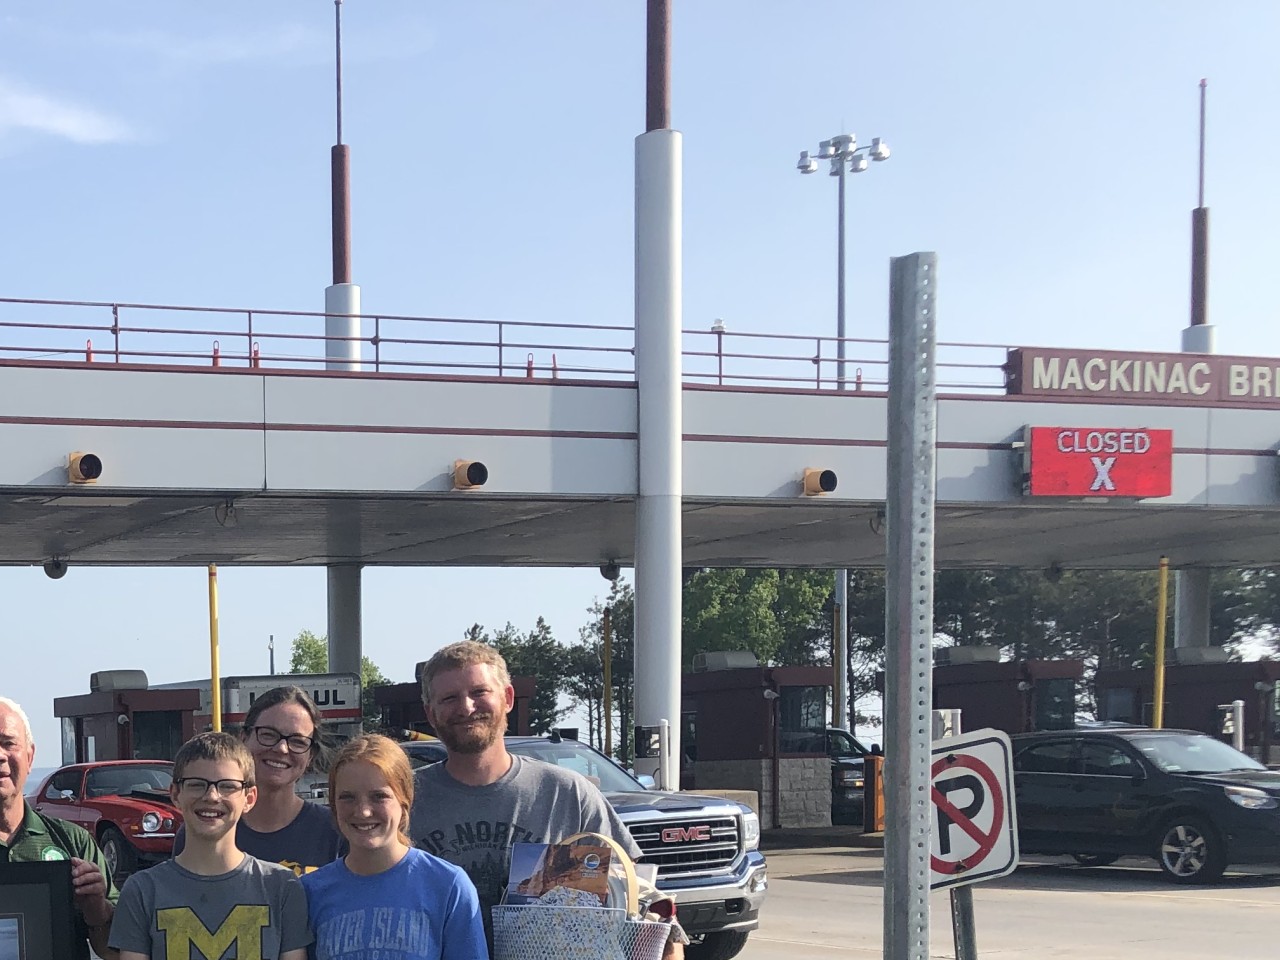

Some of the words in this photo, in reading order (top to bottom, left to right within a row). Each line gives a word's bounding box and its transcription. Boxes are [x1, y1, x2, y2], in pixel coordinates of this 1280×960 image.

[1033, 357, 1211, 395] MACKINAC
[1057, 431, 1150, 454] CLOSED
[661, 825, 711, 843] GMC
[368, 907, 430, 957] ISLAND
